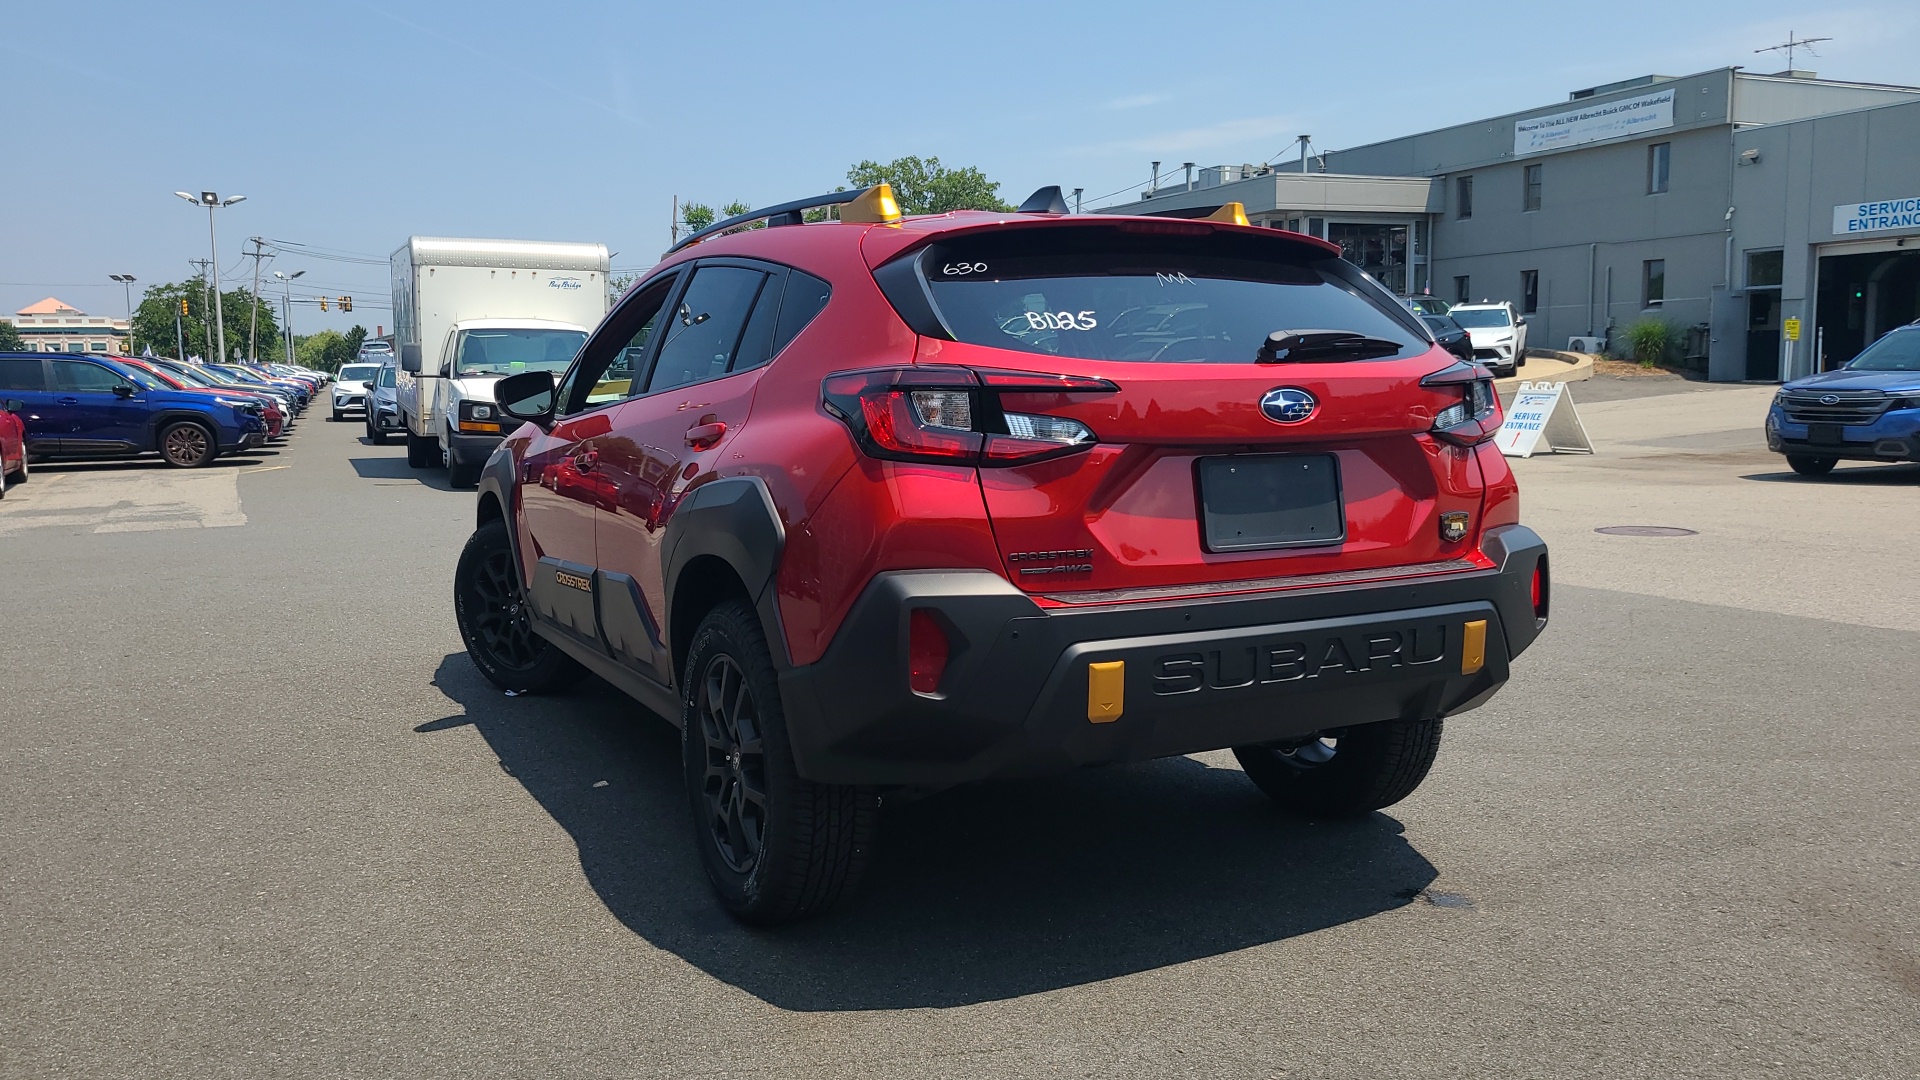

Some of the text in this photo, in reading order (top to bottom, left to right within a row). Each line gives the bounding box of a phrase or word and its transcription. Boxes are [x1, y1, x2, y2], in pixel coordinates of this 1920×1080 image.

[1566, 115, 1579, 124] NEW
[1580, 111, 1602, 121] Albrecht
[1603, 107, 1618, 116] Buick
[1619, 103, 1632, 113] GMC
[1633, 101, 1640, 109] Of
[1642, 96, 1671, 108] Wakefield
[943, 261, 988, 275] 630
[561, 281, 582, 290] Bridge
[1513, 412, 1543, 421] SERVICE
[1504, 422, 1542, 431] ENTRANCE
[1008, 549, 1094, 561] CROSSTREK
[1050, 564, 1093, 574] AWD
[556, 571, 591, 592] CROSSTREK
[1152, 624, 1447, 696] SUBARU
